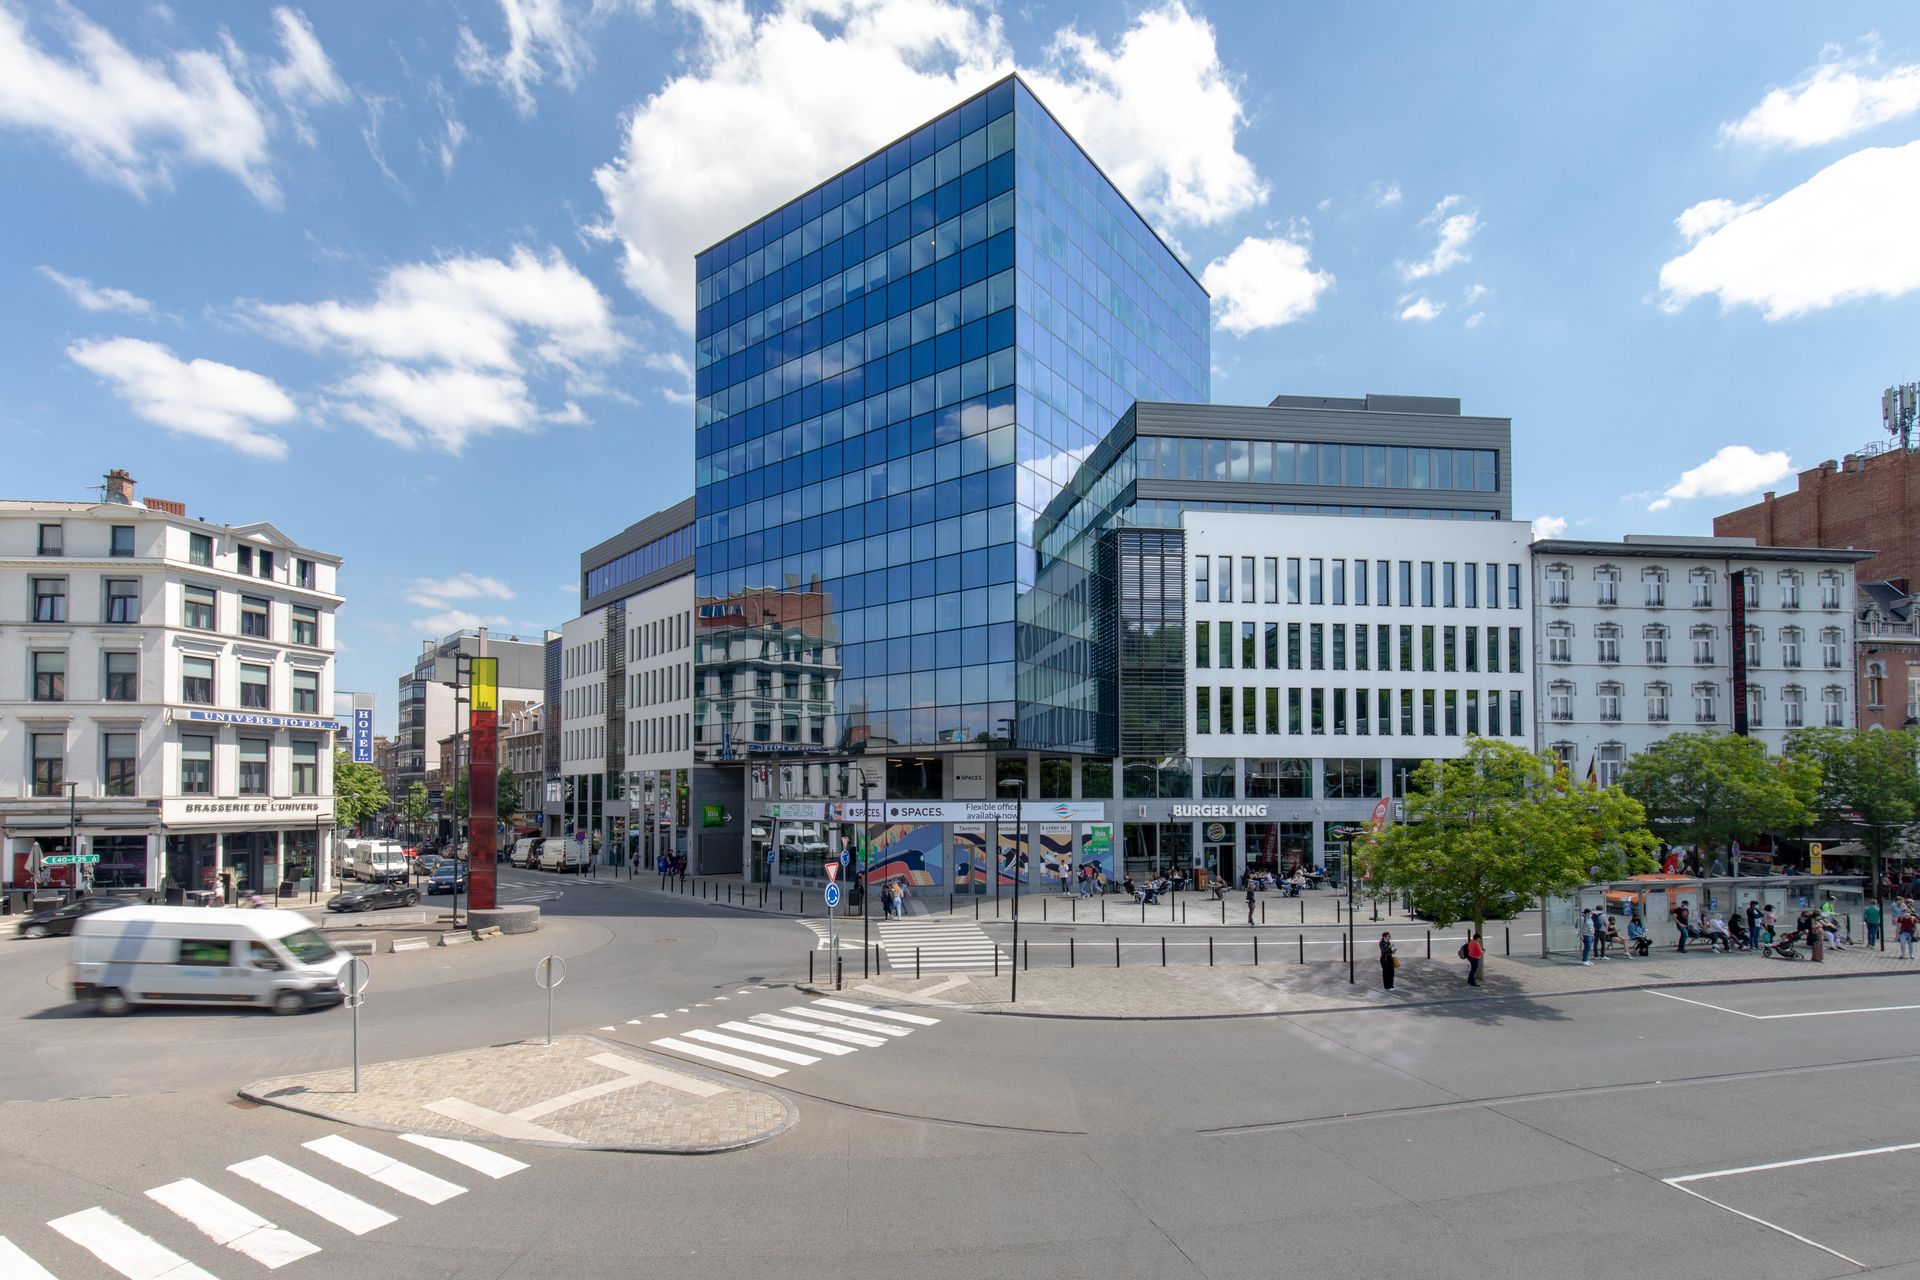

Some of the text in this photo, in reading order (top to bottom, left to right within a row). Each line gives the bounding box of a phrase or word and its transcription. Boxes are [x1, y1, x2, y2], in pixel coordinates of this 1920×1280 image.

[204, 712, 326, 729] UNIVERS HOTEL
[358, 710, 370, 757] HOTEL
[185, 803, 319, 813] BRASSERIE DE L'UNIVERS
[901, 807, 944, 817] SPACES.
[966, 803, 1022, 811] Flexible offices
[1173, 804, 1267, 817] BURGER KING
[966, 812, 1001, 820] available
[1811, 844, 1821, 857] C
